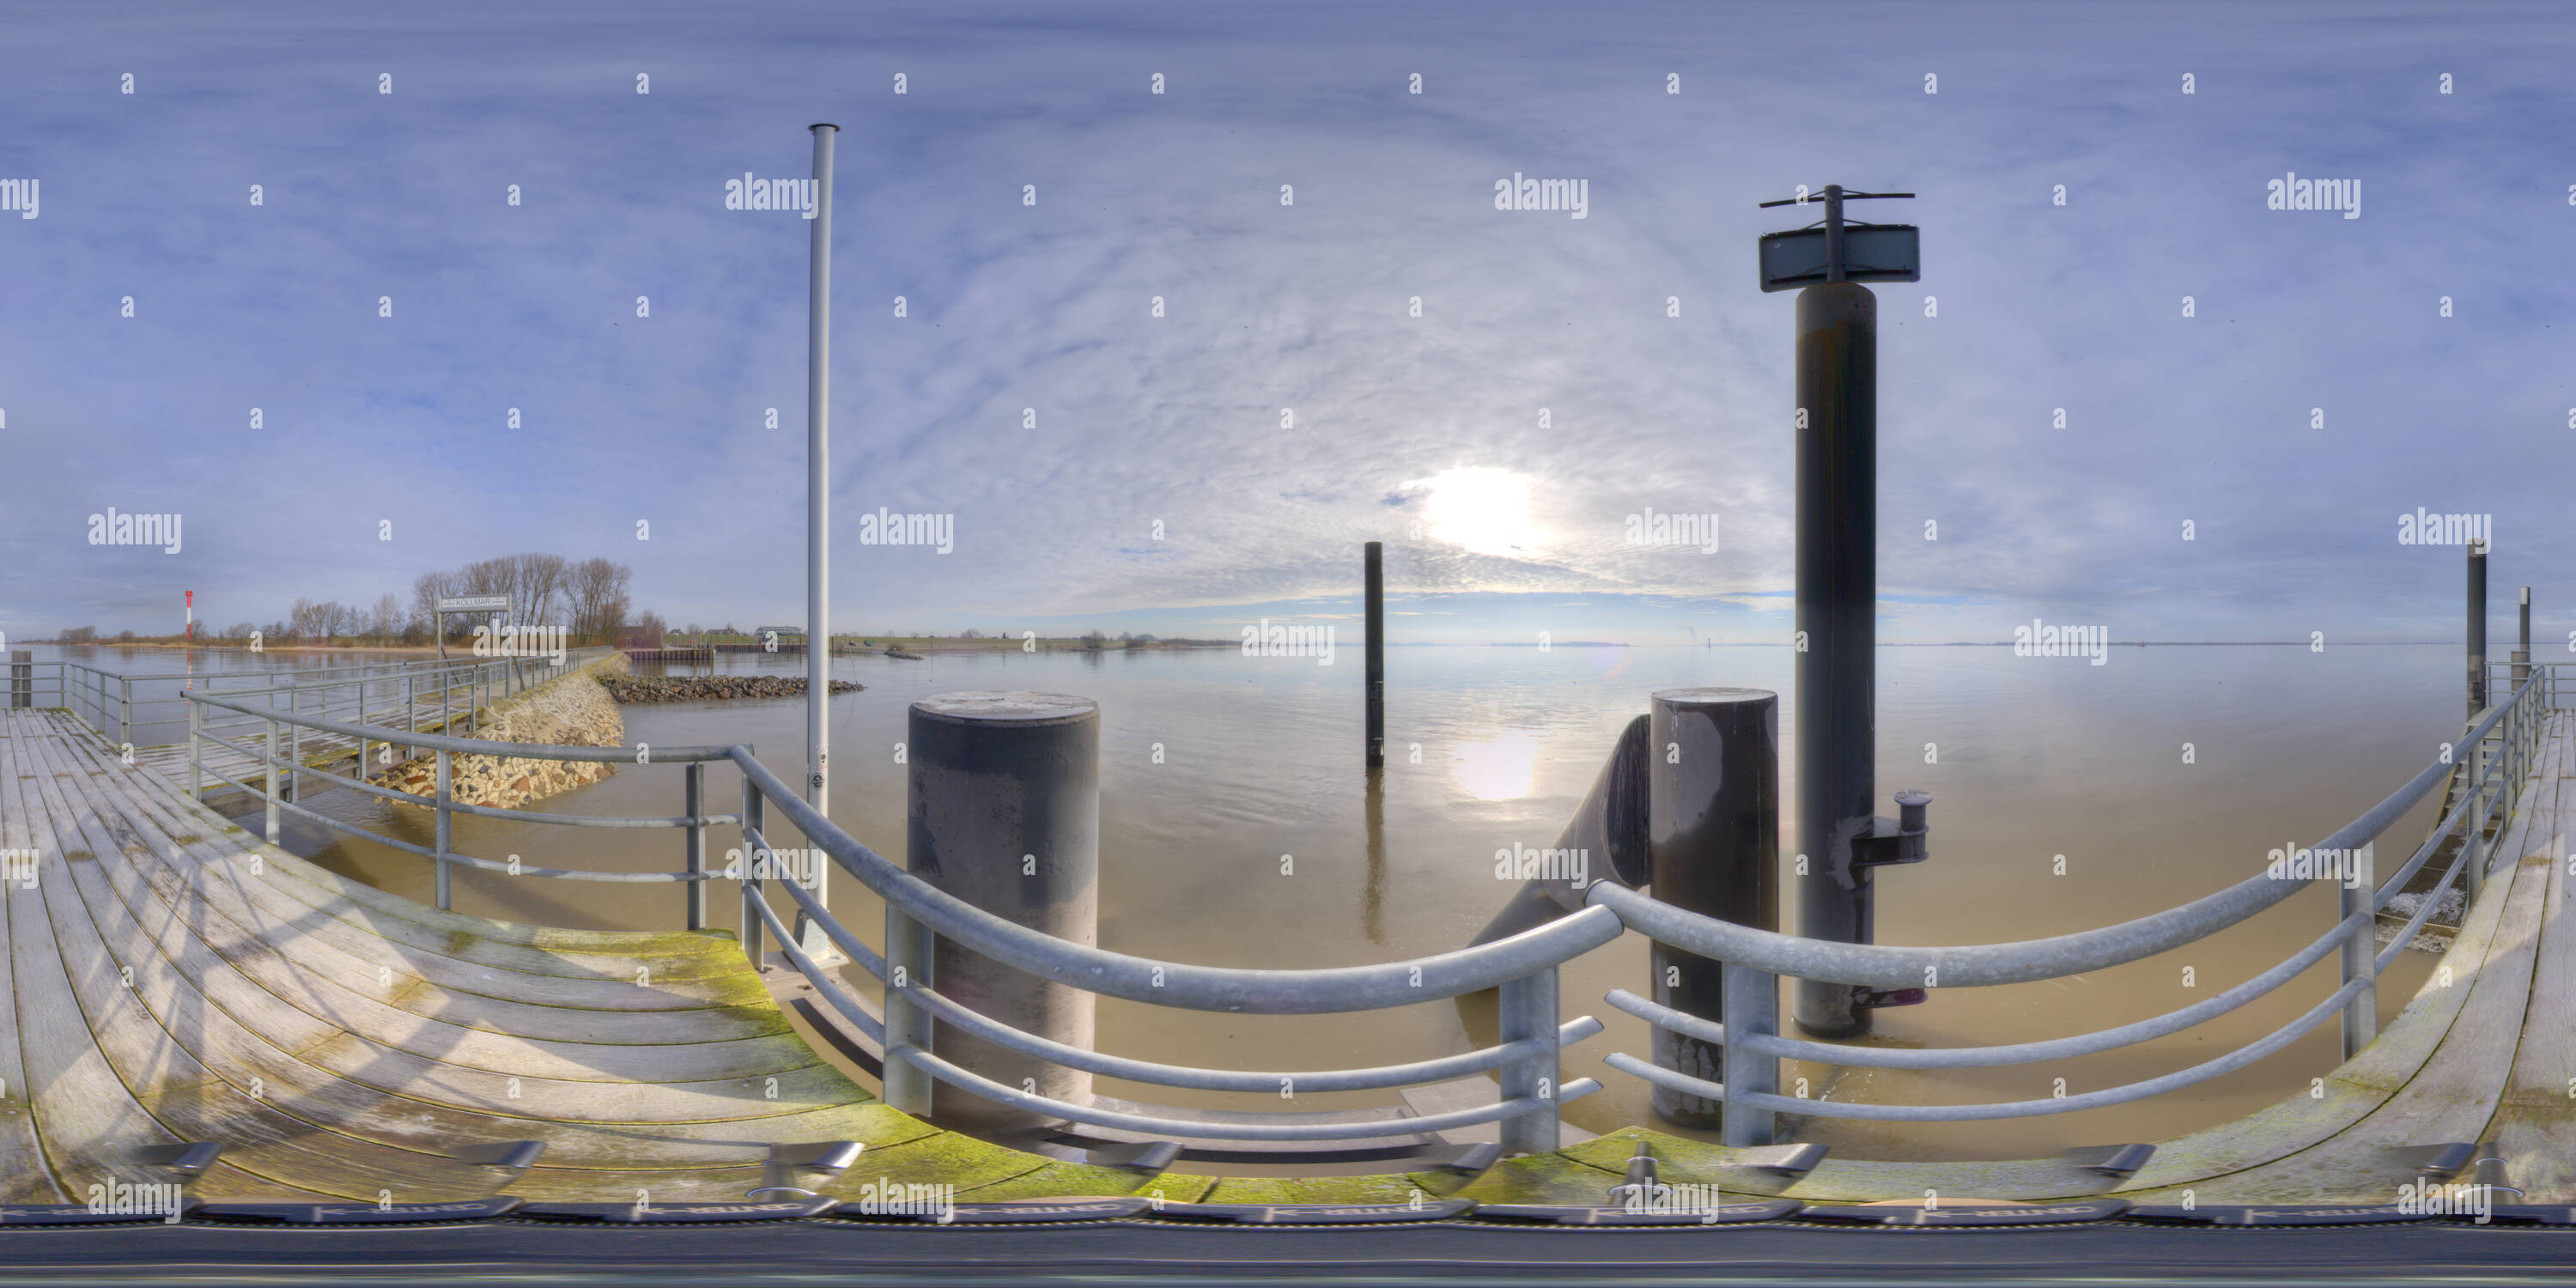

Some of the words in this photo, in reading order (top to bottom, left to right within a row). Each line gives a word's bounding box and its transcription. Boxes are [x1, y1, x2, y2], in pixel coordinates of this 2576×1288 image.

[456, 598, 491, 606] KOLLMAR
[687, 1203, 805, 1213] CENTER
[1003, 1204, 1121, 1214] CENTER
[1974, 1206, 2096, 1217] CENTER
